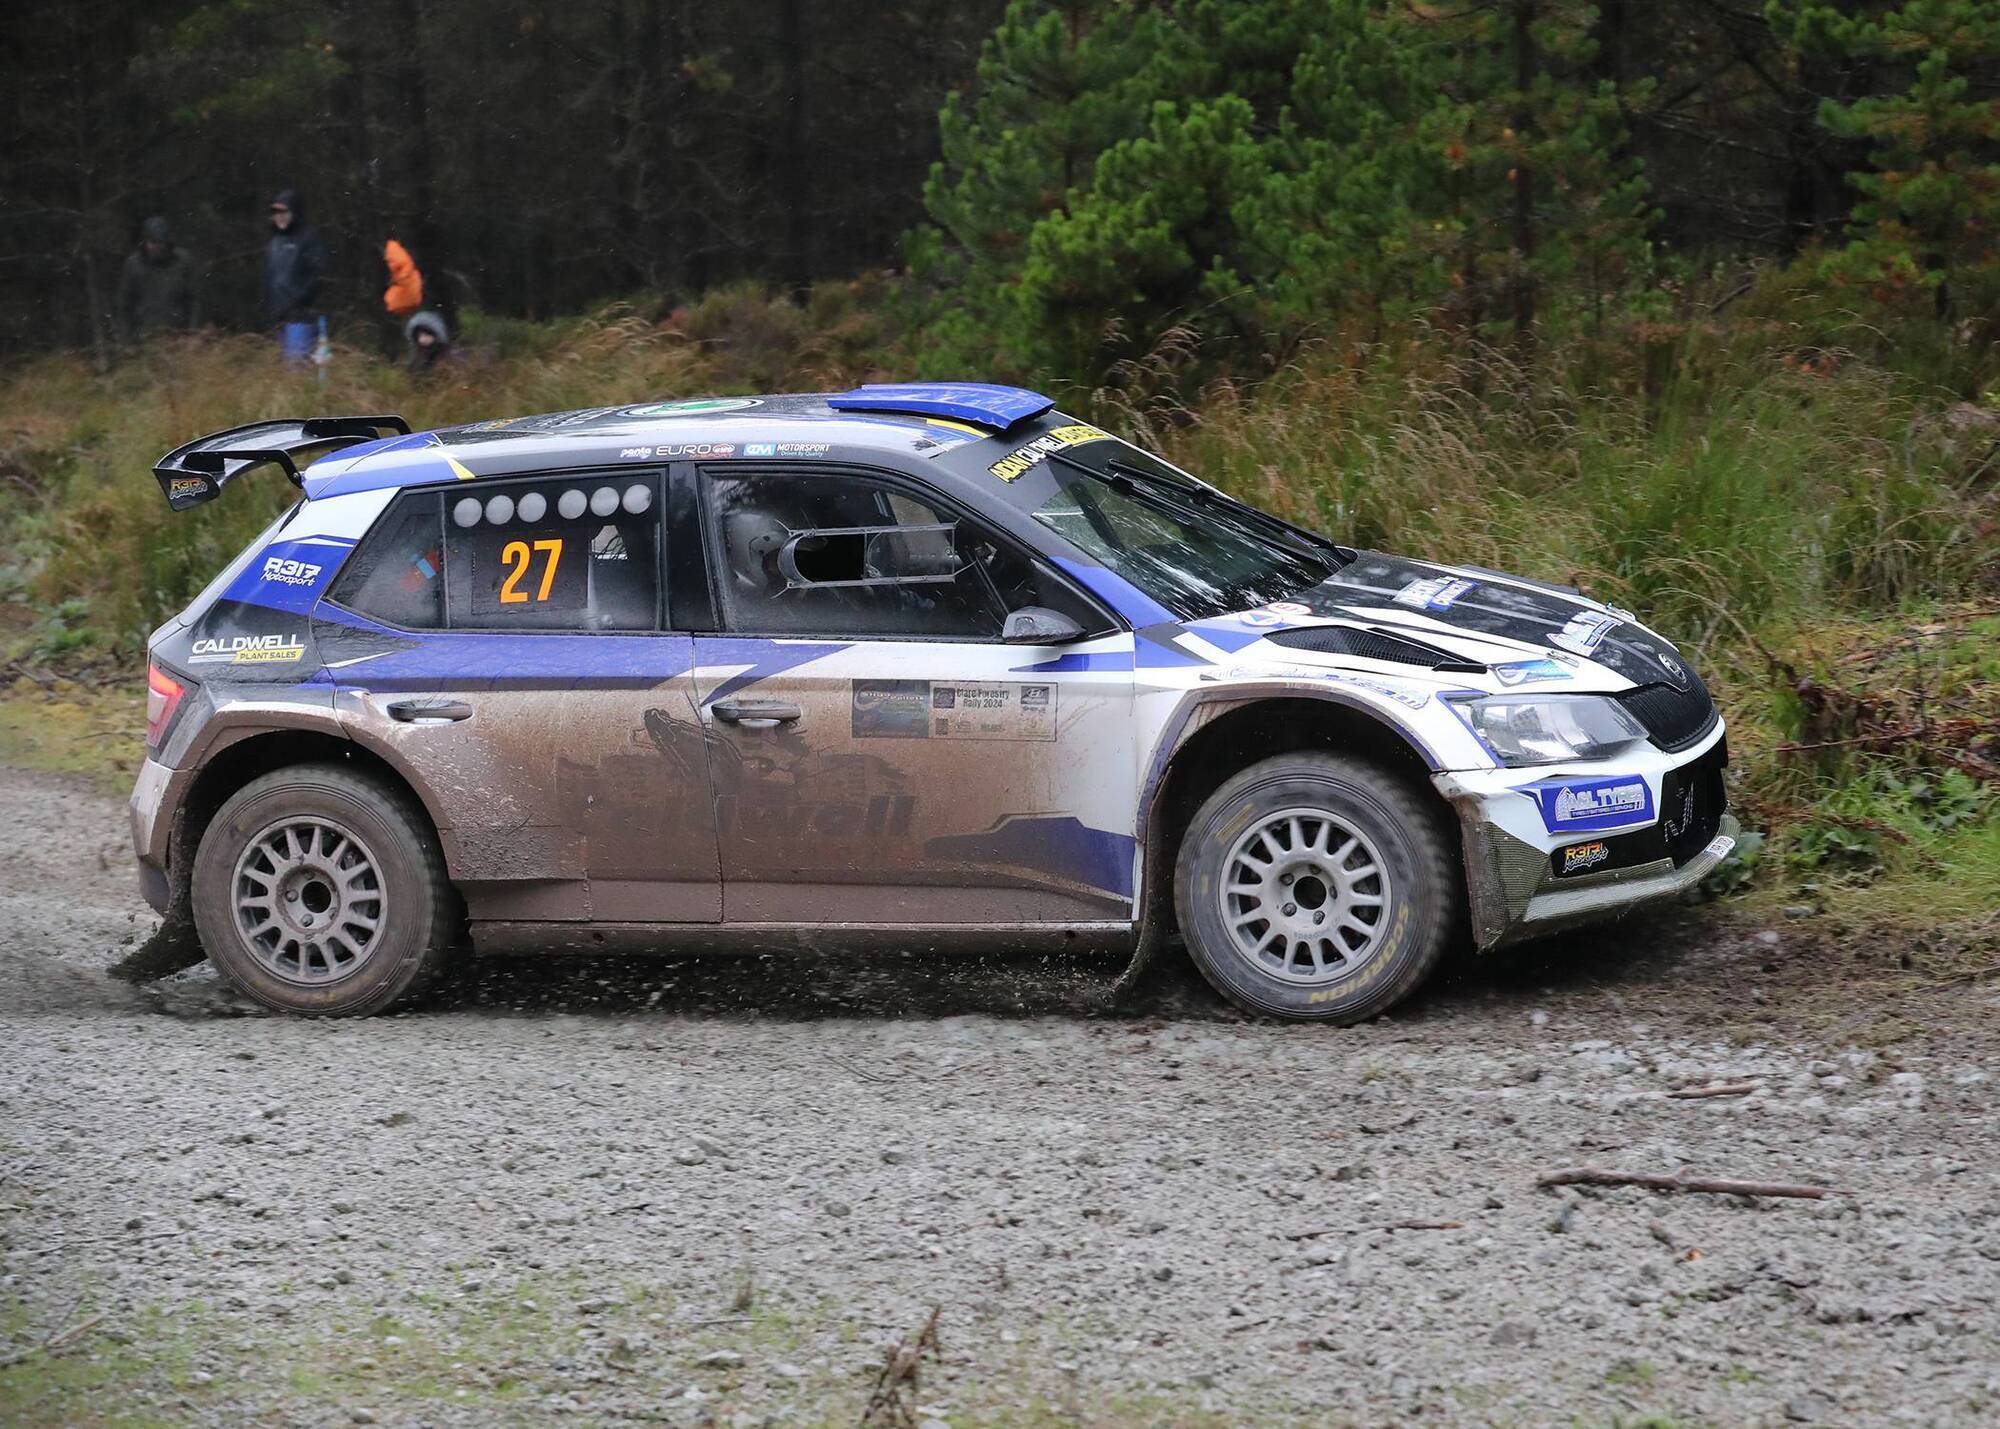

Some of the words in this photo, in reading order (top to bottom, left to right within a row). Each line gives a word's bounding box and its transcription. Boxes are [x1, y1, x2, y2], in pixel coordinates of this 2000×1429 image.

[656, 444, 711, 455] EURO
[776, 443, 830, 452] MOTORSPORT
[500, 539, 562, 604] 27
[192, 634, 304, 654] CALDWELL
[240, 652, 268, 660] PLANT
[270, 650, 296, 659] SALES
[983, 699, 1003, 708] 2024
[1310, 903, 1409, 1003] SCORPION
